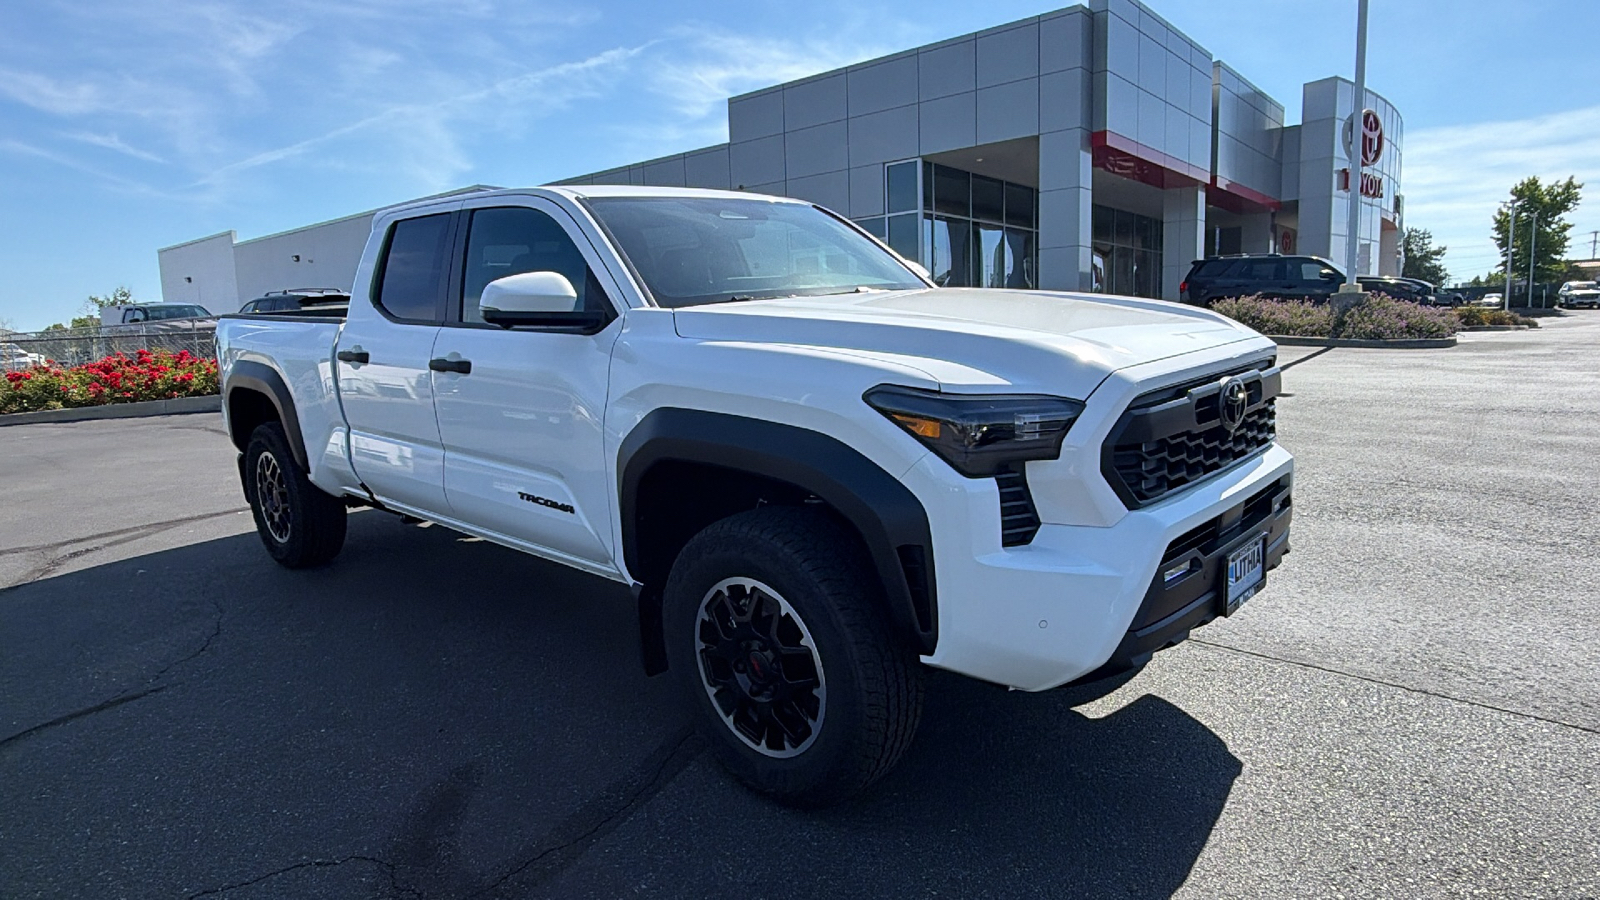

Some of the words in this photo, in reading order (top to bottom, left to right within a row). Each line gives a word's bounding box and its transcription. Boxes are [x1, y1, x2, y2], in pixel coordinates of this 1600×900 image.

[1341, 168, 1383, 198] TYOTA
[518, 491, 575, 514] TACOMA
[1234, 546, 1262, 584] LITHIA
